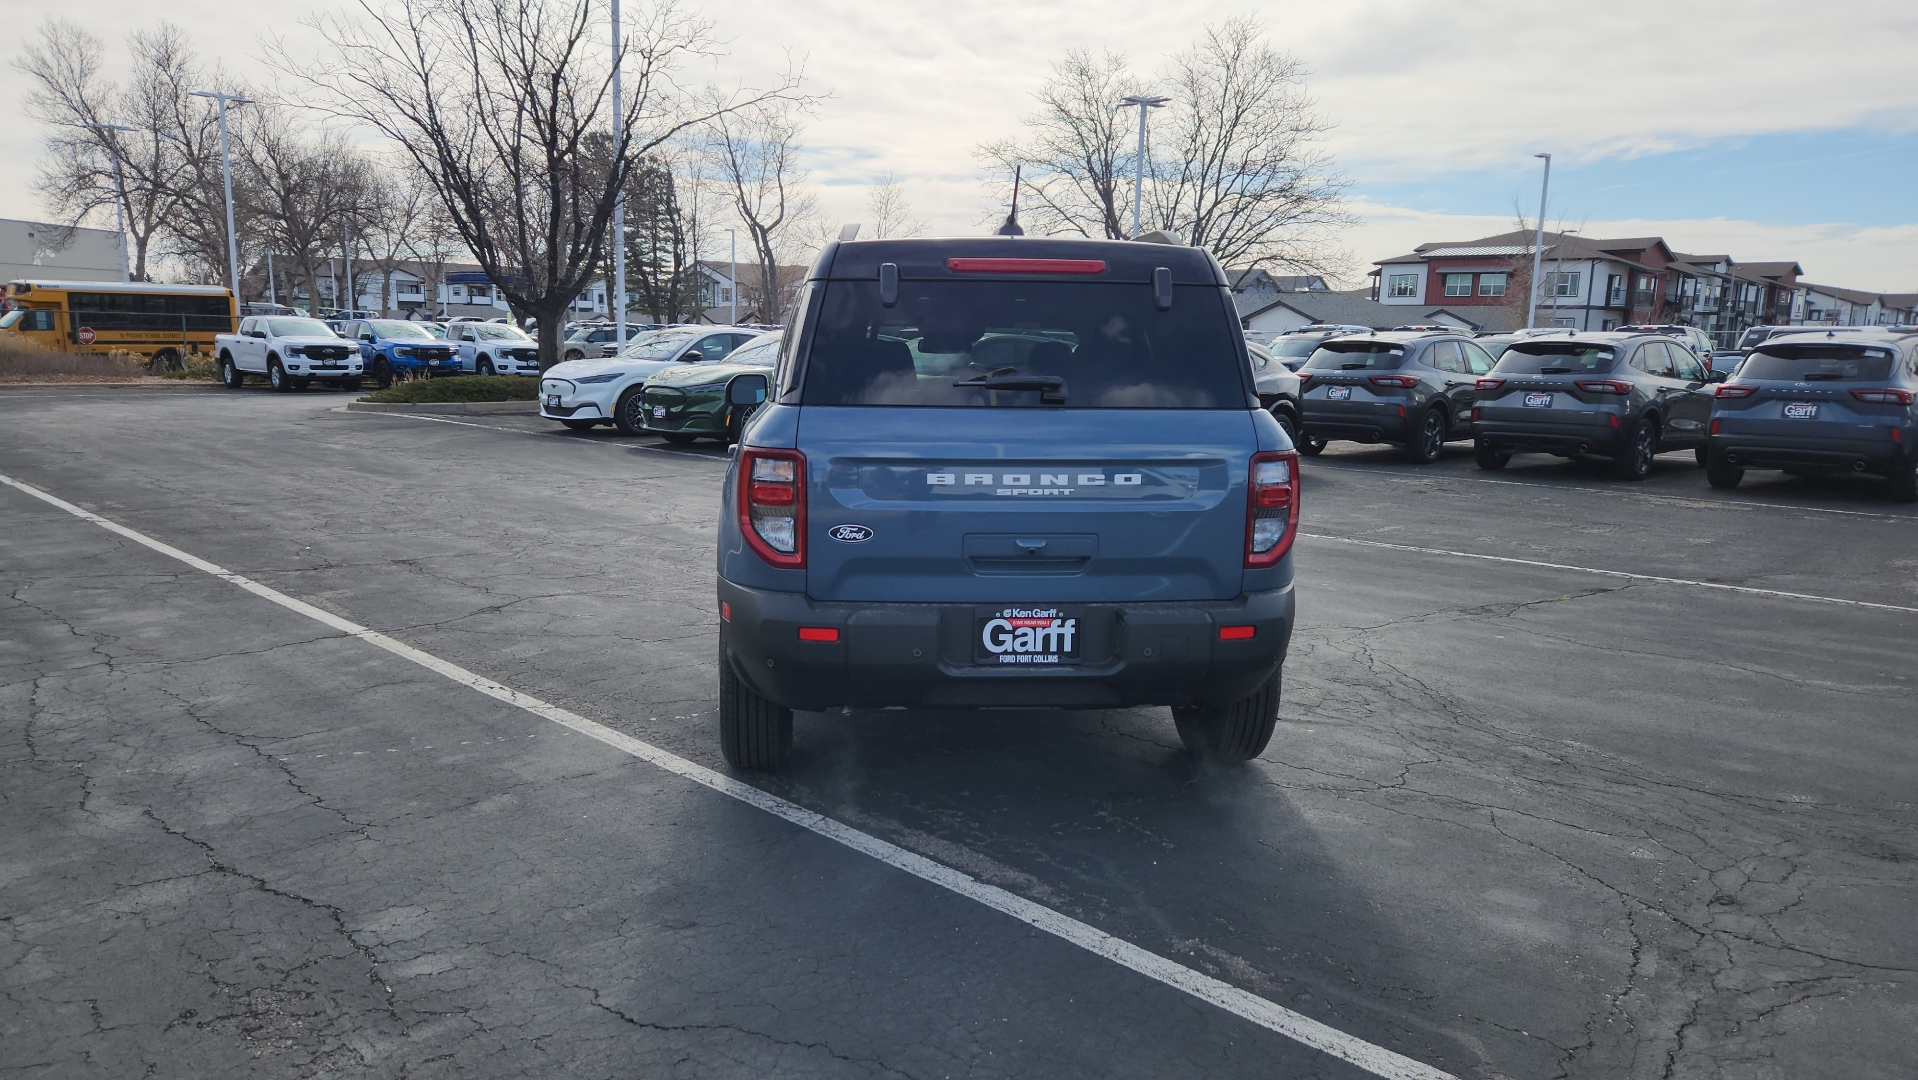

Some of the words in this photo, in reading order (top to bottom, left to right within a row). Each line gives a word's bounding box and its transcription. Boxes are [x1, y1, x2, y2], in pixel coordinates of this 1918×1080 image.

[1328, 388, 1350, 398] Garff
[1525, 395, 1551, 405] Garff
[1784, 404, 1817, 416] Garff
[926, 473, 1142, 486] BRONCO
[996, 488, 1075, 496] SPORT
[836, 526, 866, 540] Ford
[1012, 608, 1031, 618] Ken
[1032, 608, 1057, 618] Garff
[982, 618, 1076, 654] Garff
[1000, 654, 1016, 663] FORD
[1016, 654, 1032, 663] FORT
[1033, 654, 1058, 663] COLLINS
